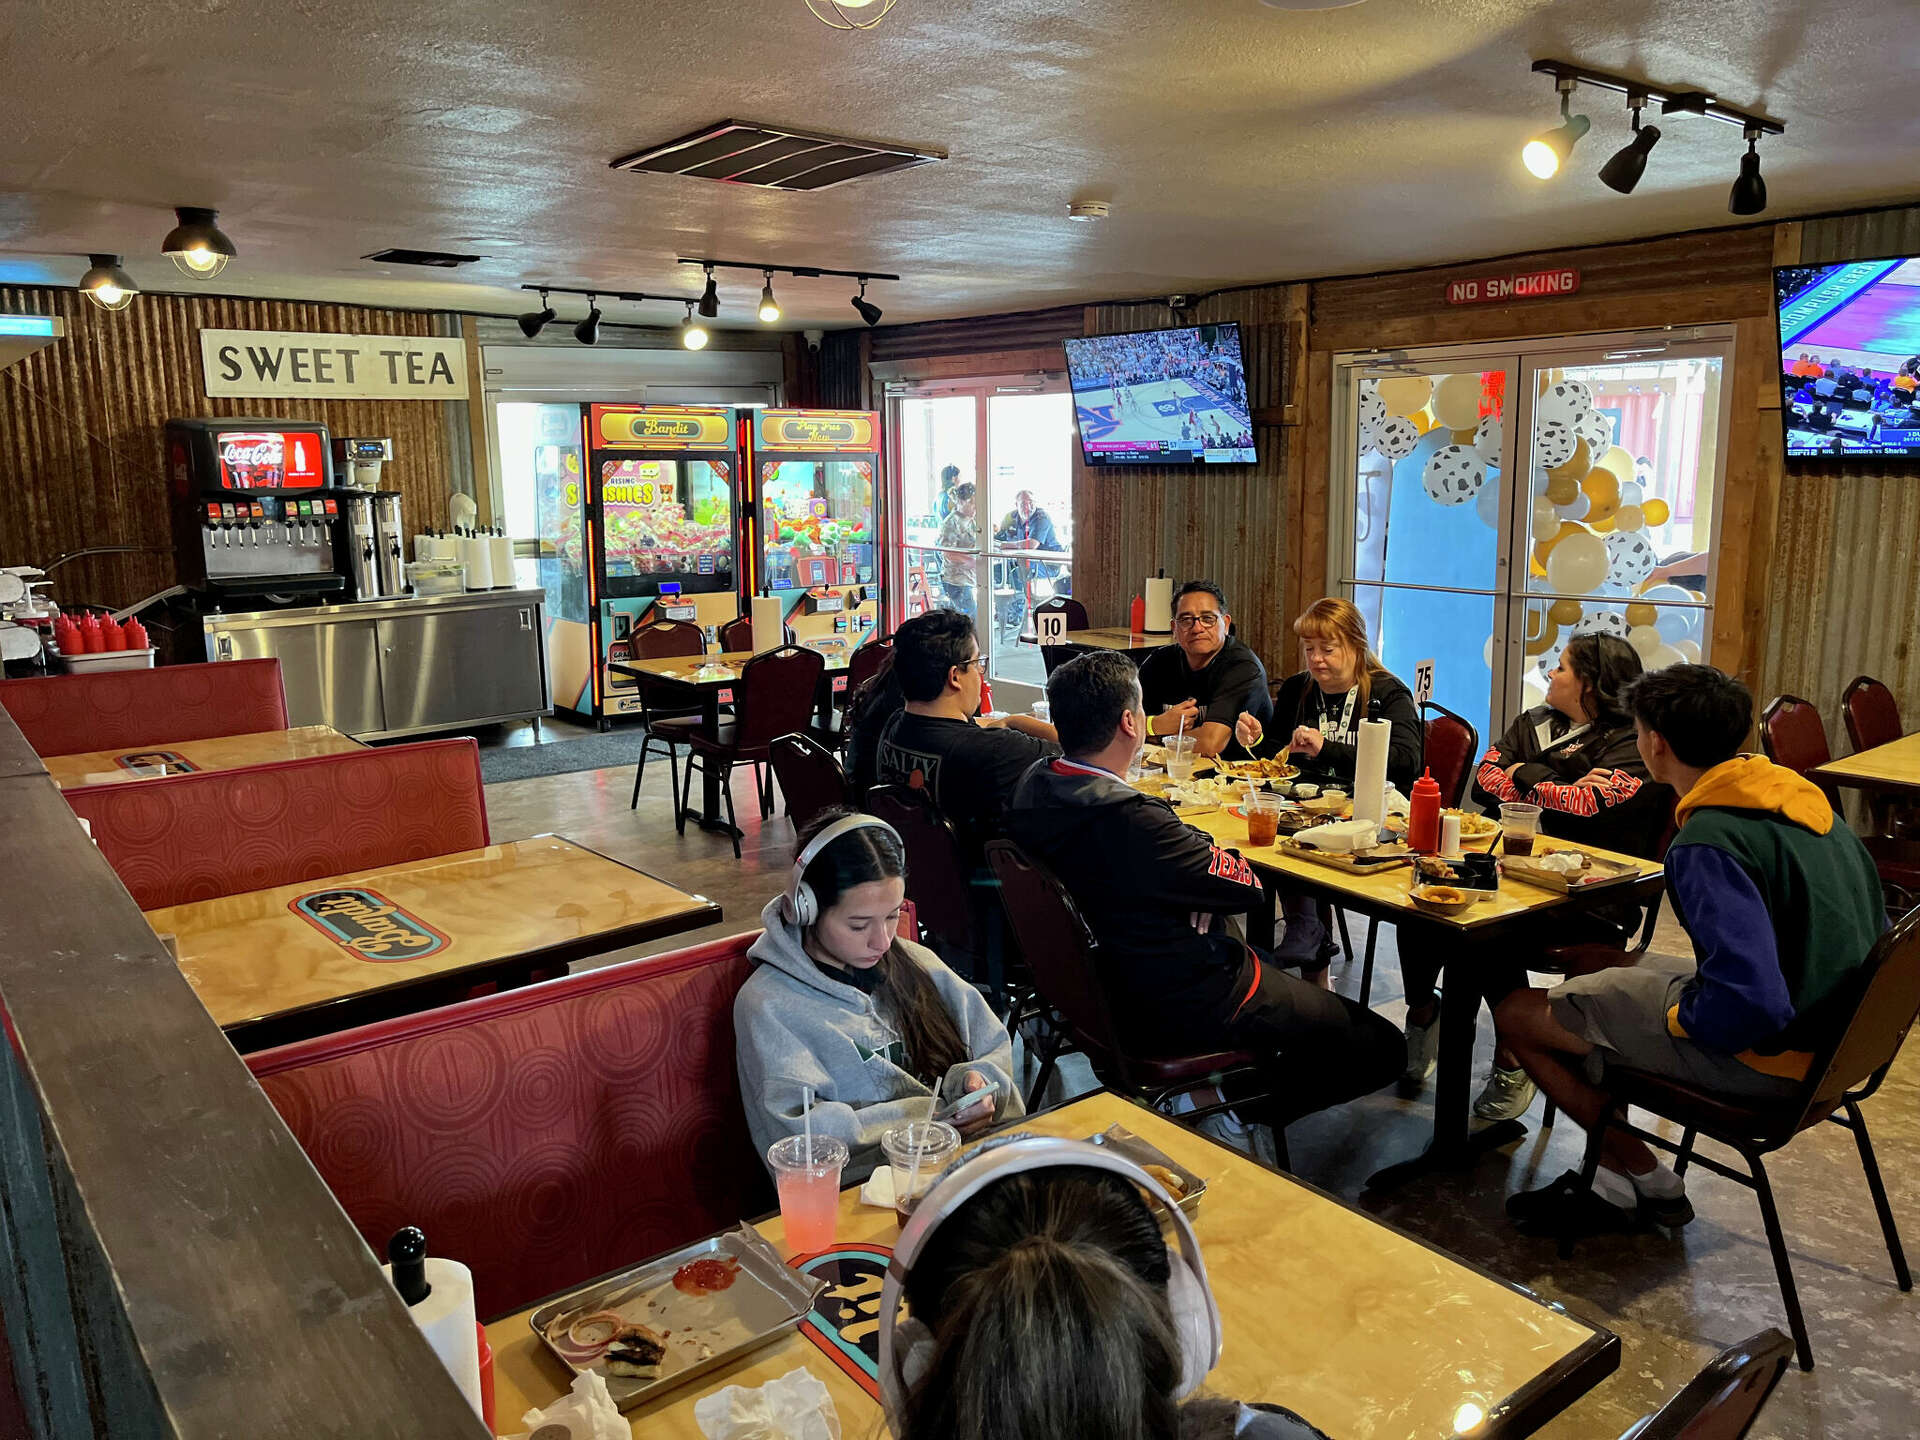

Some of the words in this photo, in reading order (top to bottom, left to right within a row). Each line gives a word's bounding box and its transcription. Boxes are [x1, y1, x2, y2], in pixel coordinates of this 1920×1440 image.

[1453, 282, 1478, 301] NO
[1486, 272, 1573, 297] SMOKING
[218, 345, 360, 384] SWEET
[379, 350, 455, 385] TEA
[644, 419, 689, 439] Bandit
[1043, 618, 1061, 637] 10
[1417, 666, 1432, 693] 75
[880, 744, 937, 782] SALTY
[317, 895, 432, 953] Bandit
